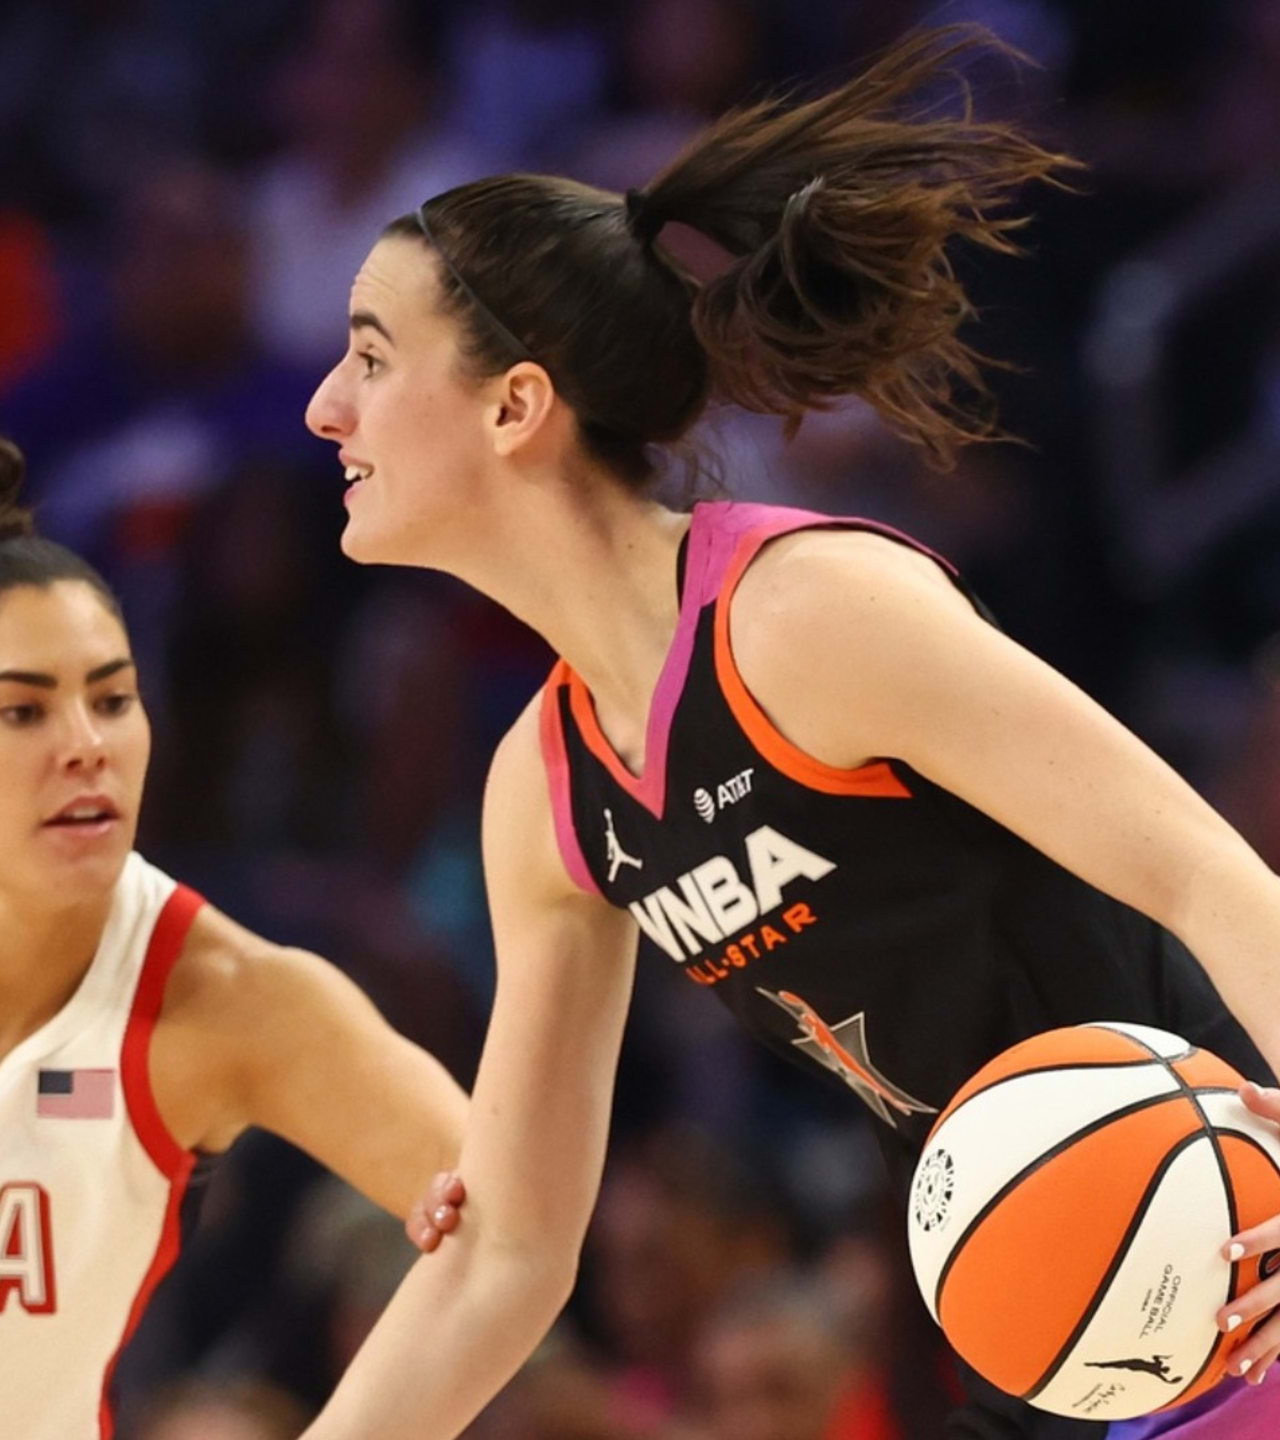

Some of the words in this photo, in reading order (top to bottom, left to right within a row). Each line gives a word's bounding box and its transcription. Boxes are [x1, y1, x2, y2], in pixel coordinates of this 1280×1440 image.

[717, 768, 754, 810] AT&T
[1153, 1263, 1174, 1306] GAME
[1153, 1275, 1182, 1333] OFFICIAL
[1138, 1306, 1160, 1340] BALL
